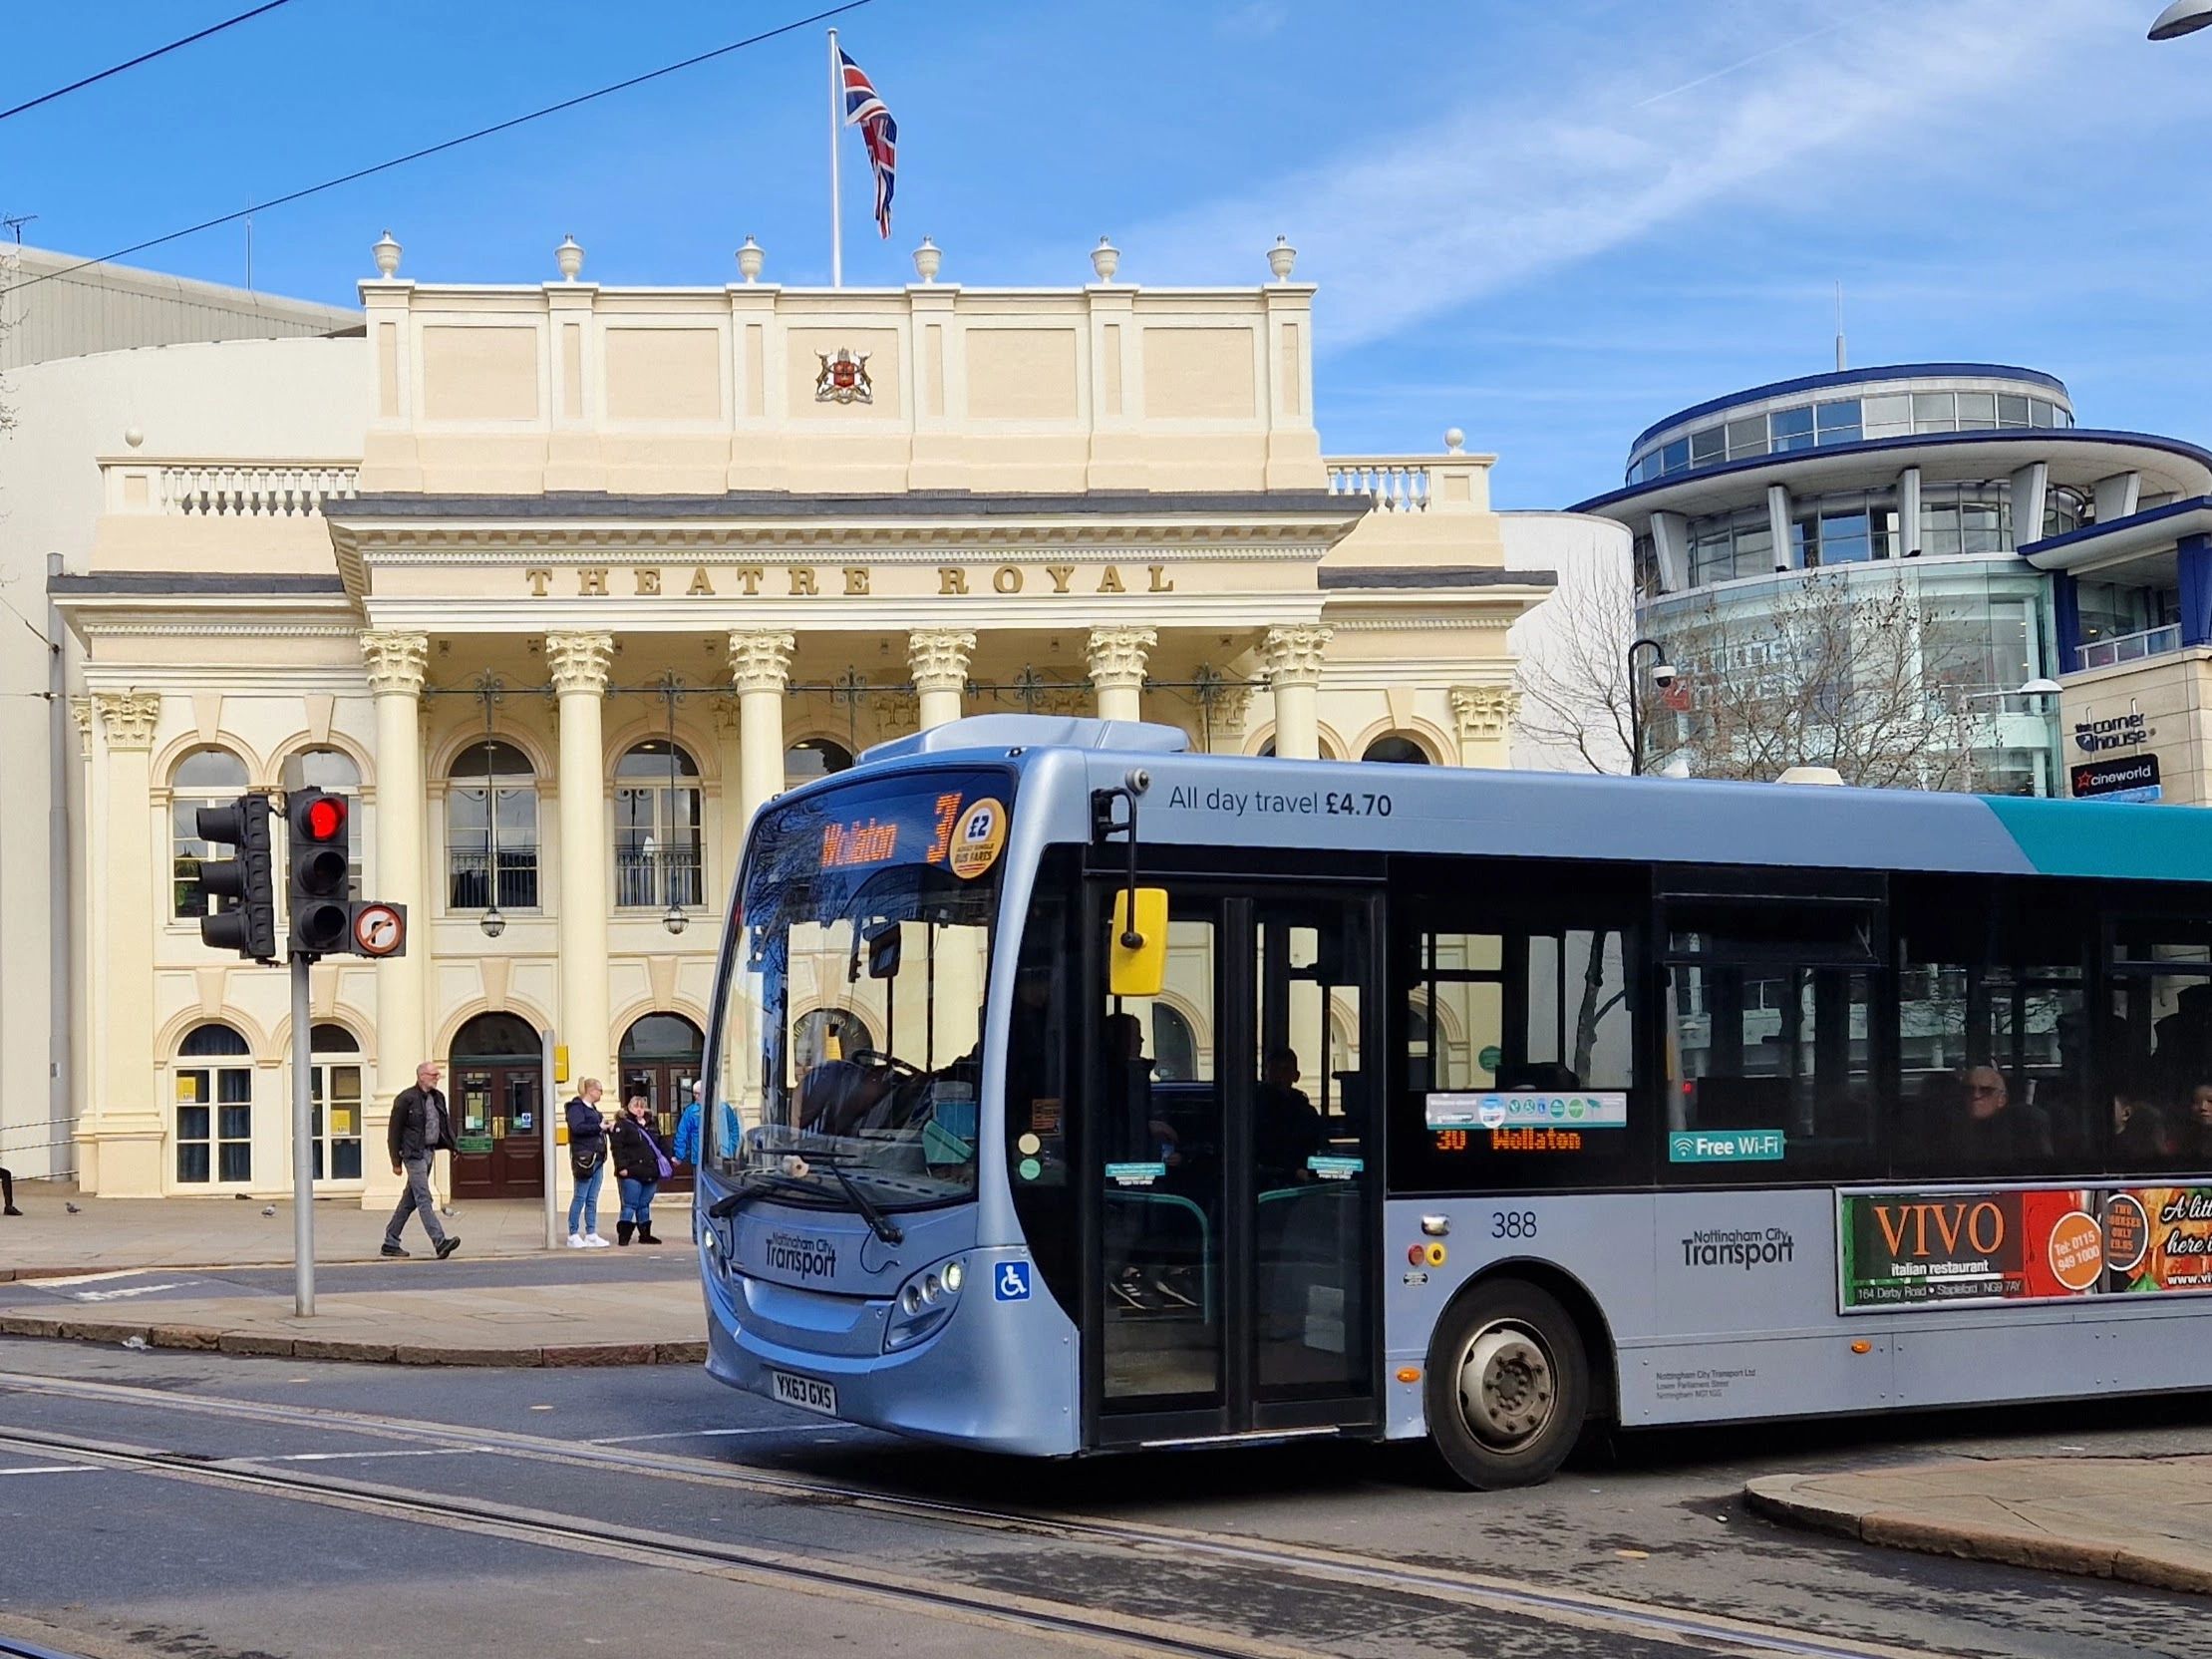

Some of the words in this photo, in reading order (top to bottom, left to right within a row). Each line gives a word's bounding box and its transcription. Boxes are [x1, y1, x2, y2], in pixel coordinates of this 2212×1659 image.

[525, 566, 870, 596] THEATRE
[937, 564, 1173, 594] ROYAL
[2093, 713, 2144, 734] corner
[2094, 730, 2147, 751] house
[2090, 765, 2151, 786] cineworld
[1169, 786, 1198, 809] All
[1206, 788, 1249, 817] day
[1256, 791, 1318, 814] travel
[1326, 793, 1393, 817] £4.70
[968, 815, 990, 837] £2
[1436, 1130, 1466, 1150] 30
[1697, 1138, 1735, 1156] Free
[1738, 1137, 1778, 1155] Wi-Fi
[2161, 1194, 2186, 1221] A
[1492, 1211, 1537, 1238] 388
[1874, 1202, 2005, 1257] VIVO
[816, 1239, 832, 1254] City
[1694, 1229, 1762, 1245] Nottingham
[1765, 1228, 1787, 1243] City
[2072, 1230, 2095, 1249] 0115
[2166, 1229, 2204, 1254] here
[766, 1238, 835, 1280] Transport
[1682, 1236, 1794, 1270] Transport
[2076, 1244, 2100, 1263] 1000
[1891, 1263, 1927, 1277] italian
[1929, 1259, 1989, 1275] restaurant
[2167, 1272, 2212, 1286] www.vi
[1877, 1286, 1902, 1300] Derby
[1904, 1284, 1927, 1297] Road
[777, 1375, 806, 1402] YX63
[808, 1383, 831, 1409] GXS
